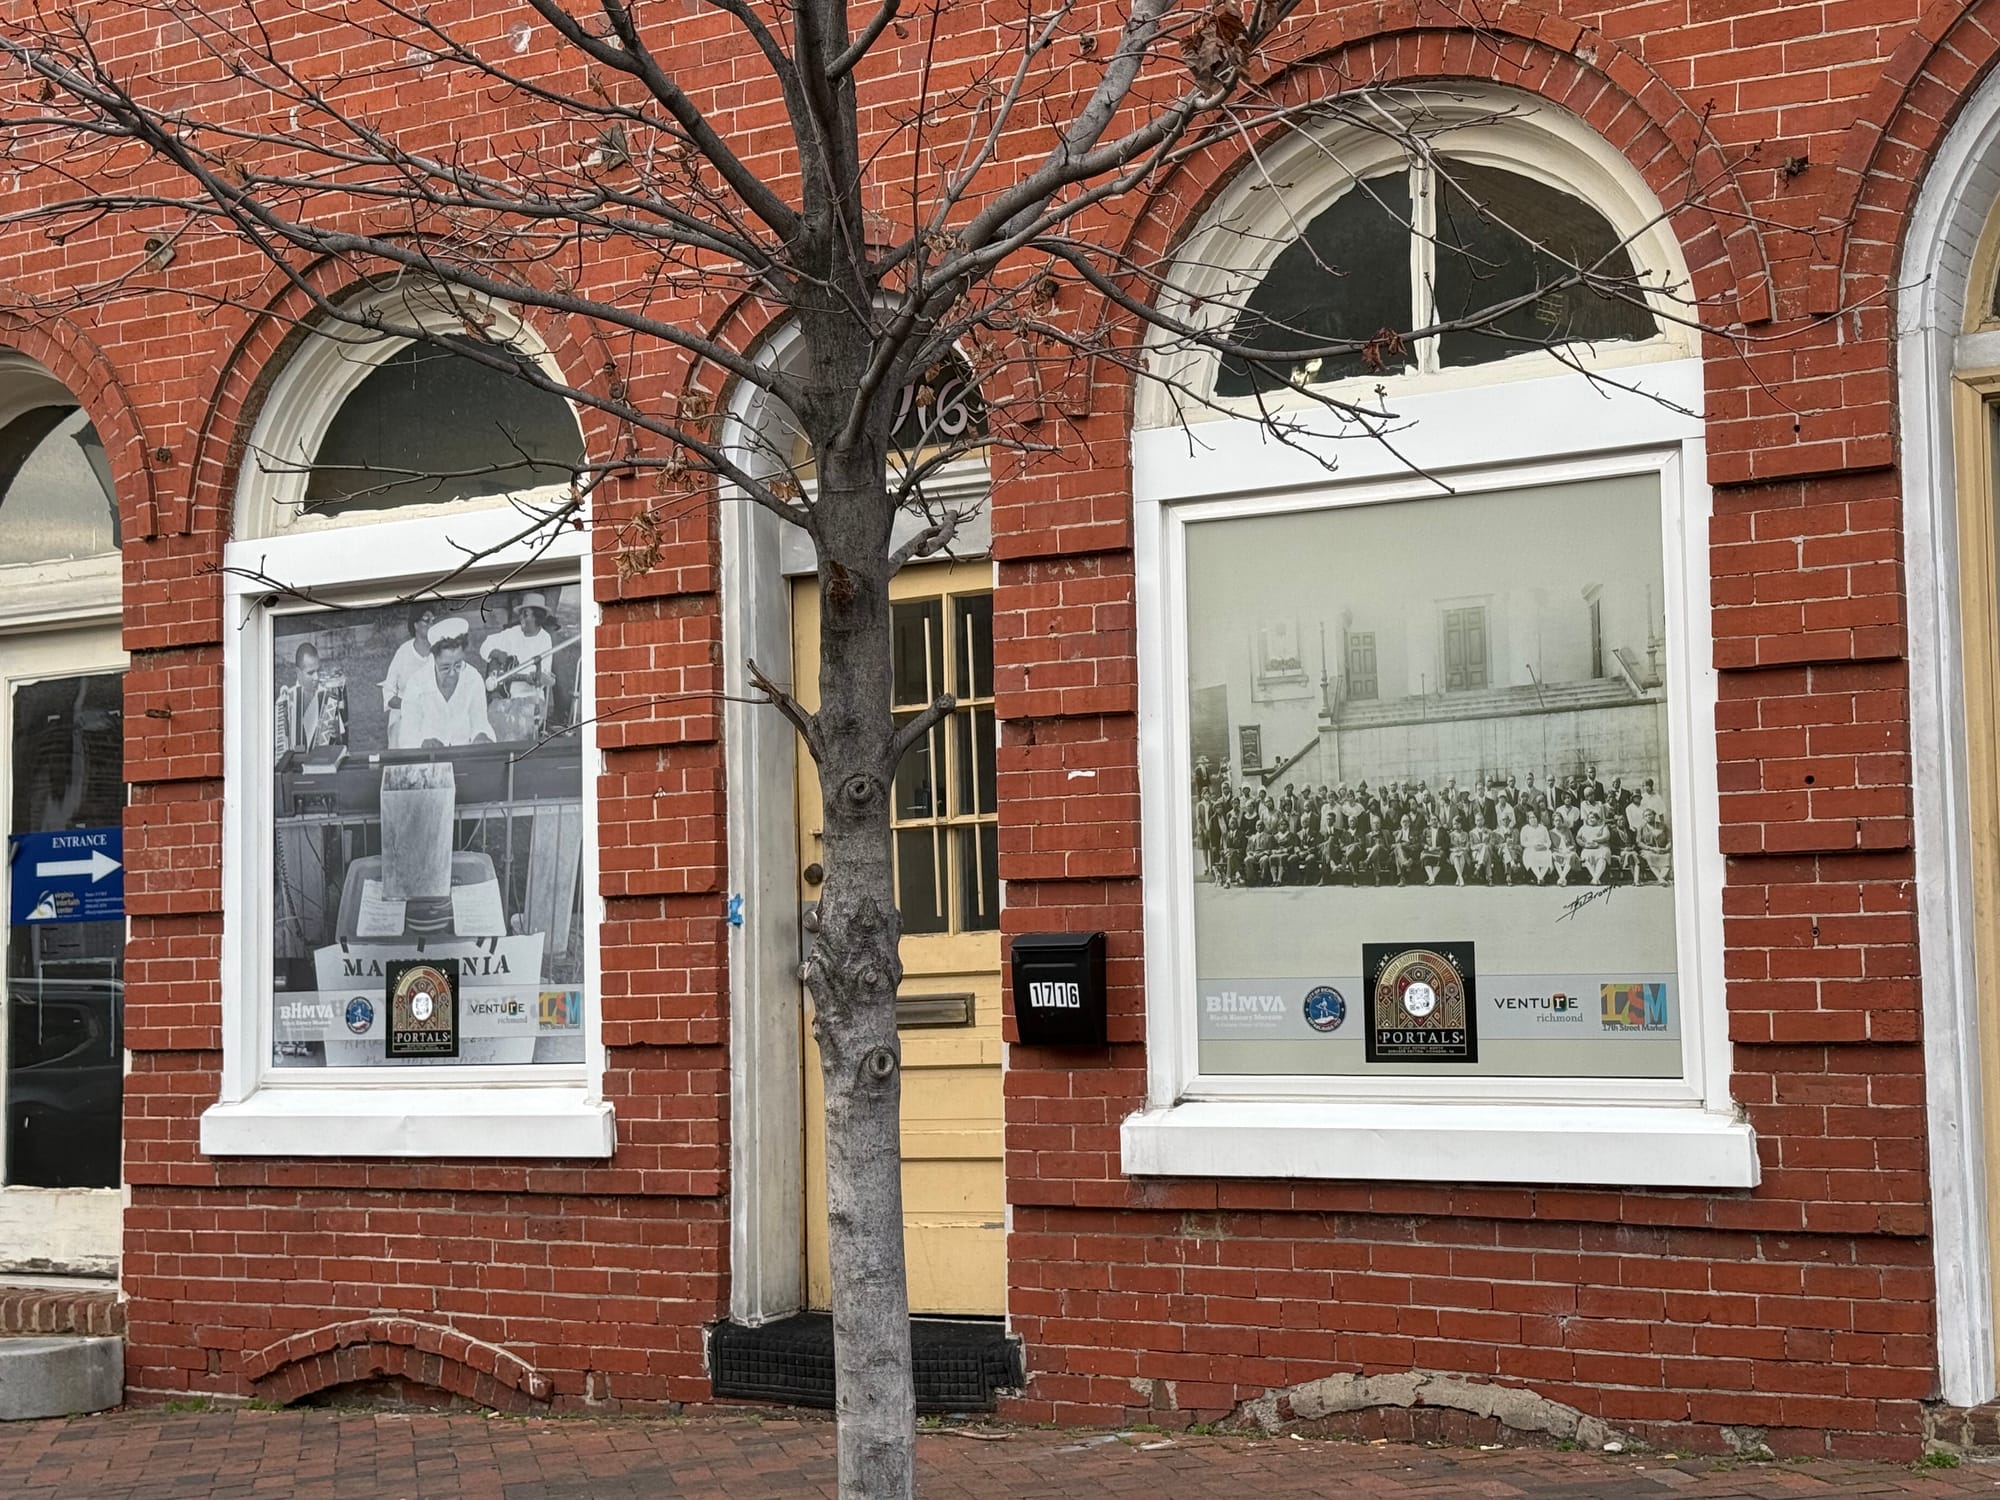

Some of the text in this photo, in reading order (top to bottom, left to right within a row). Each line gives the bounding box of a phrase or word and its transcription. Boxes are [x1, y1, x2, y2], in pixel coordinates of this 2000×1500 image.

[52, 834, 107, 849] ENTRANCE
[1031, 985, 1079, 1005] 1716
[1206, 991, 1287, 1012] BHMVA
[280, 1002, 335, 1019] BHMVA
[1536, 1013, 1584, 1023] richmond
[397, 1032, 449, 1043] PORTALS
[1382, 1031, 1460, 1044] PORTALS
